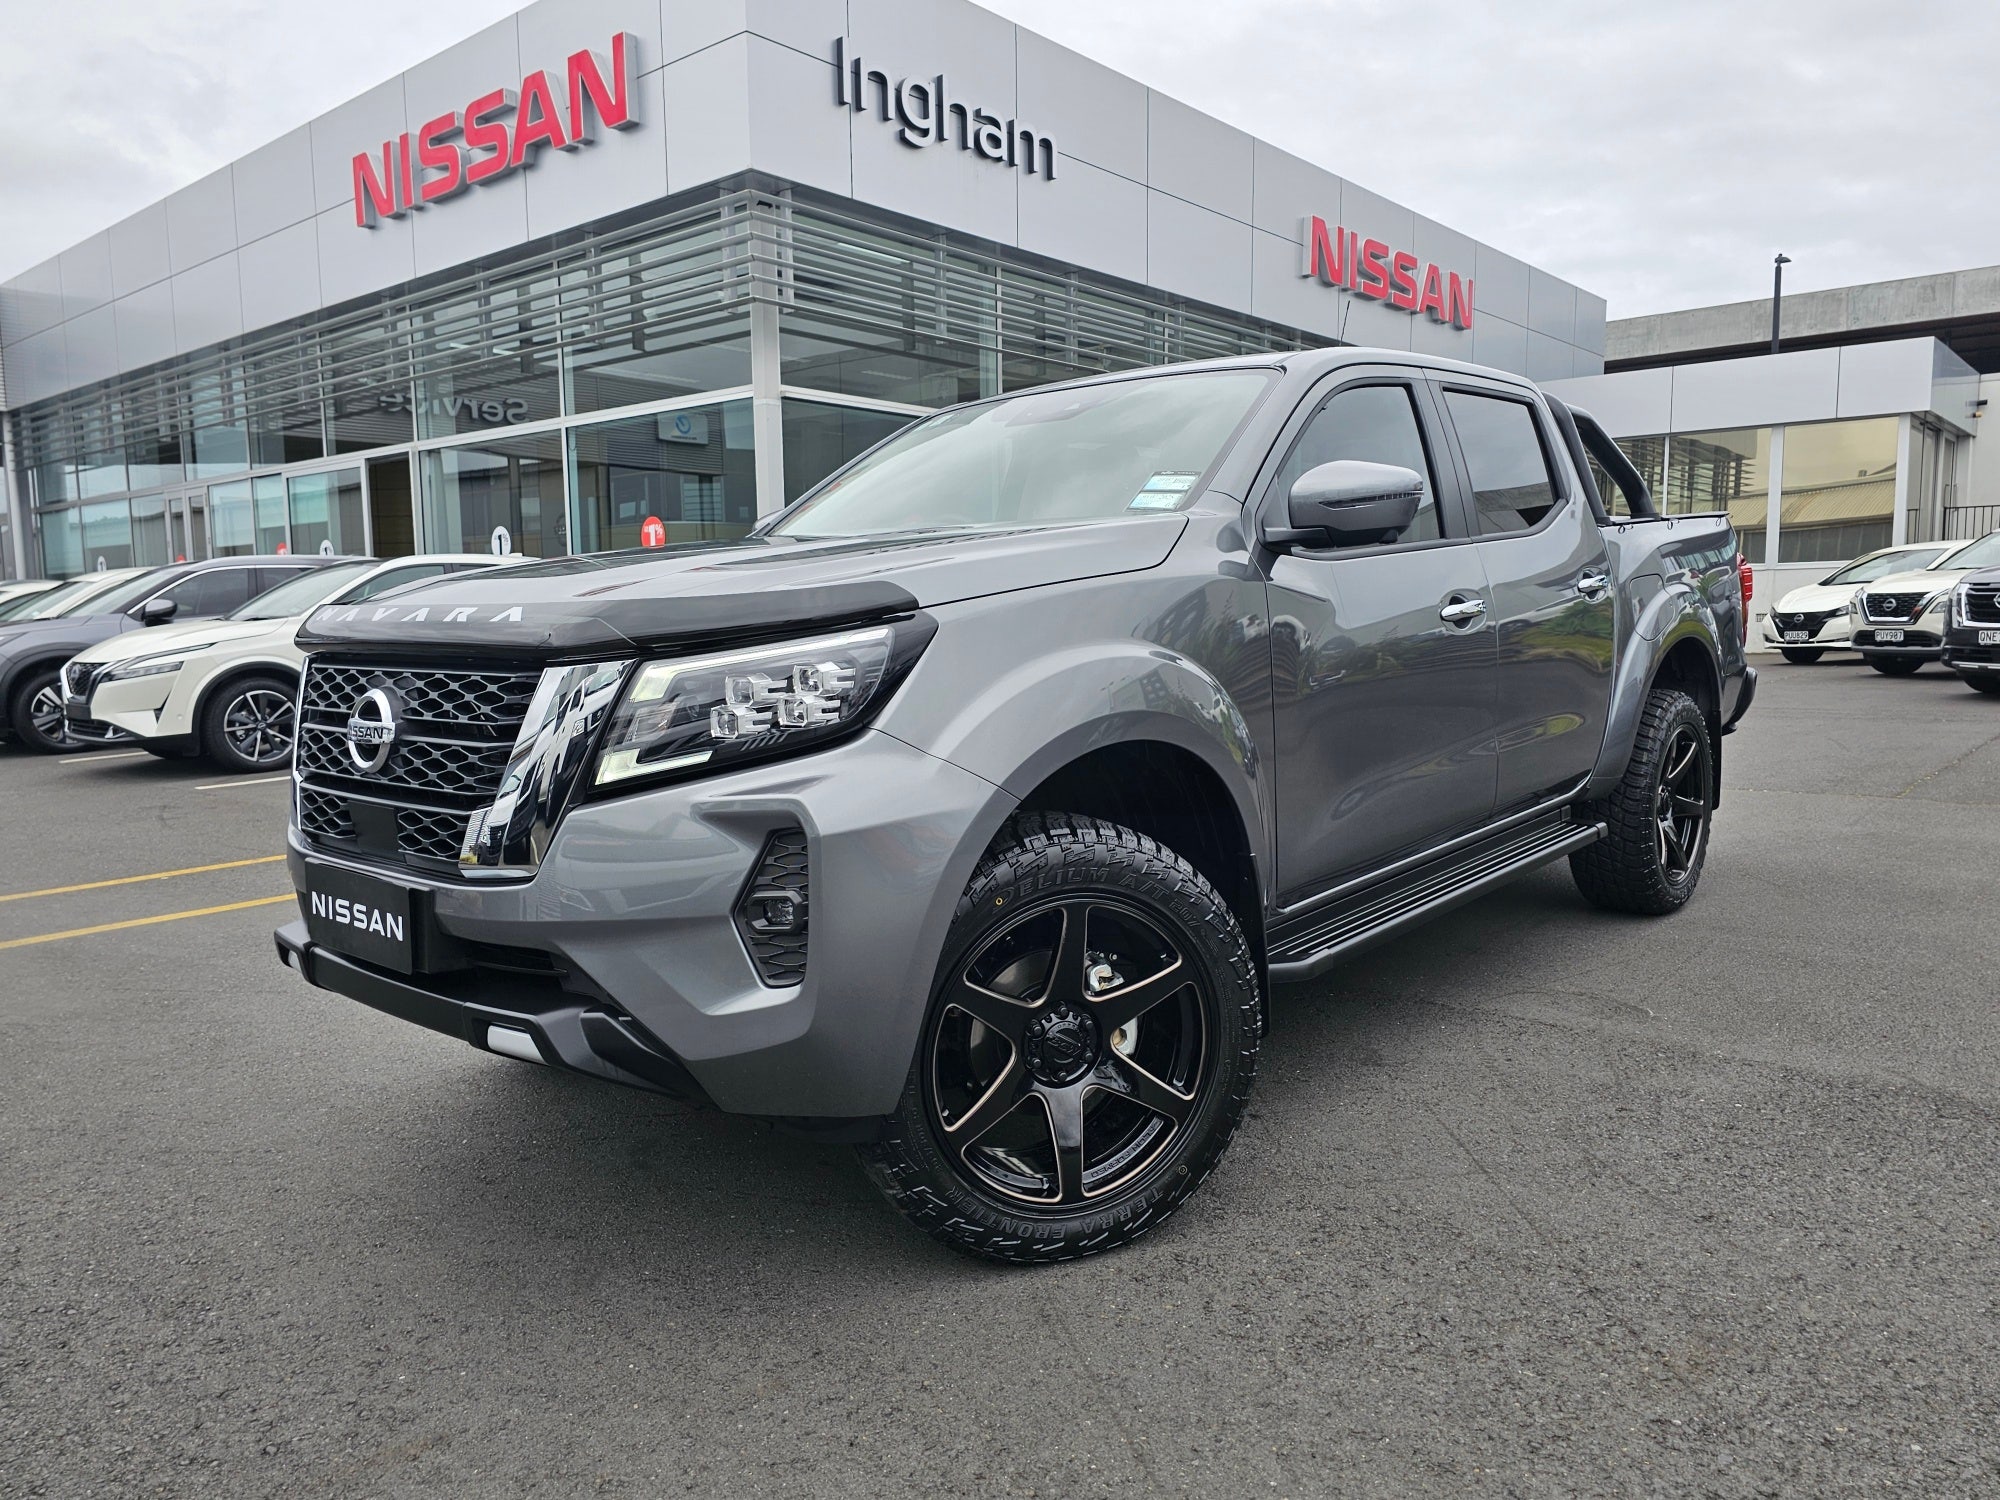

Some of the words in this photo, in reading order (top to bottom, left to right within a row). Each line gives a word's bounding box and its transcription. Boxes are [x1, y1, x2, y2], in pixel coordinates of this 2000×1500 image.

[352, 31, 634, 228] NISSAN
[834, 36, 1057, 181] Ingham
[1305, 215, 1474, 330] NISSAN
[316, 606, 524, 622] NAVARA
[1119, 873, 1172, 901] A/T
[311, 891, 404, 942] NISSAN
[945, 1185, 1068, 1239] FRONTIER
[1079, 1187, 1164, 1233] TERRA
